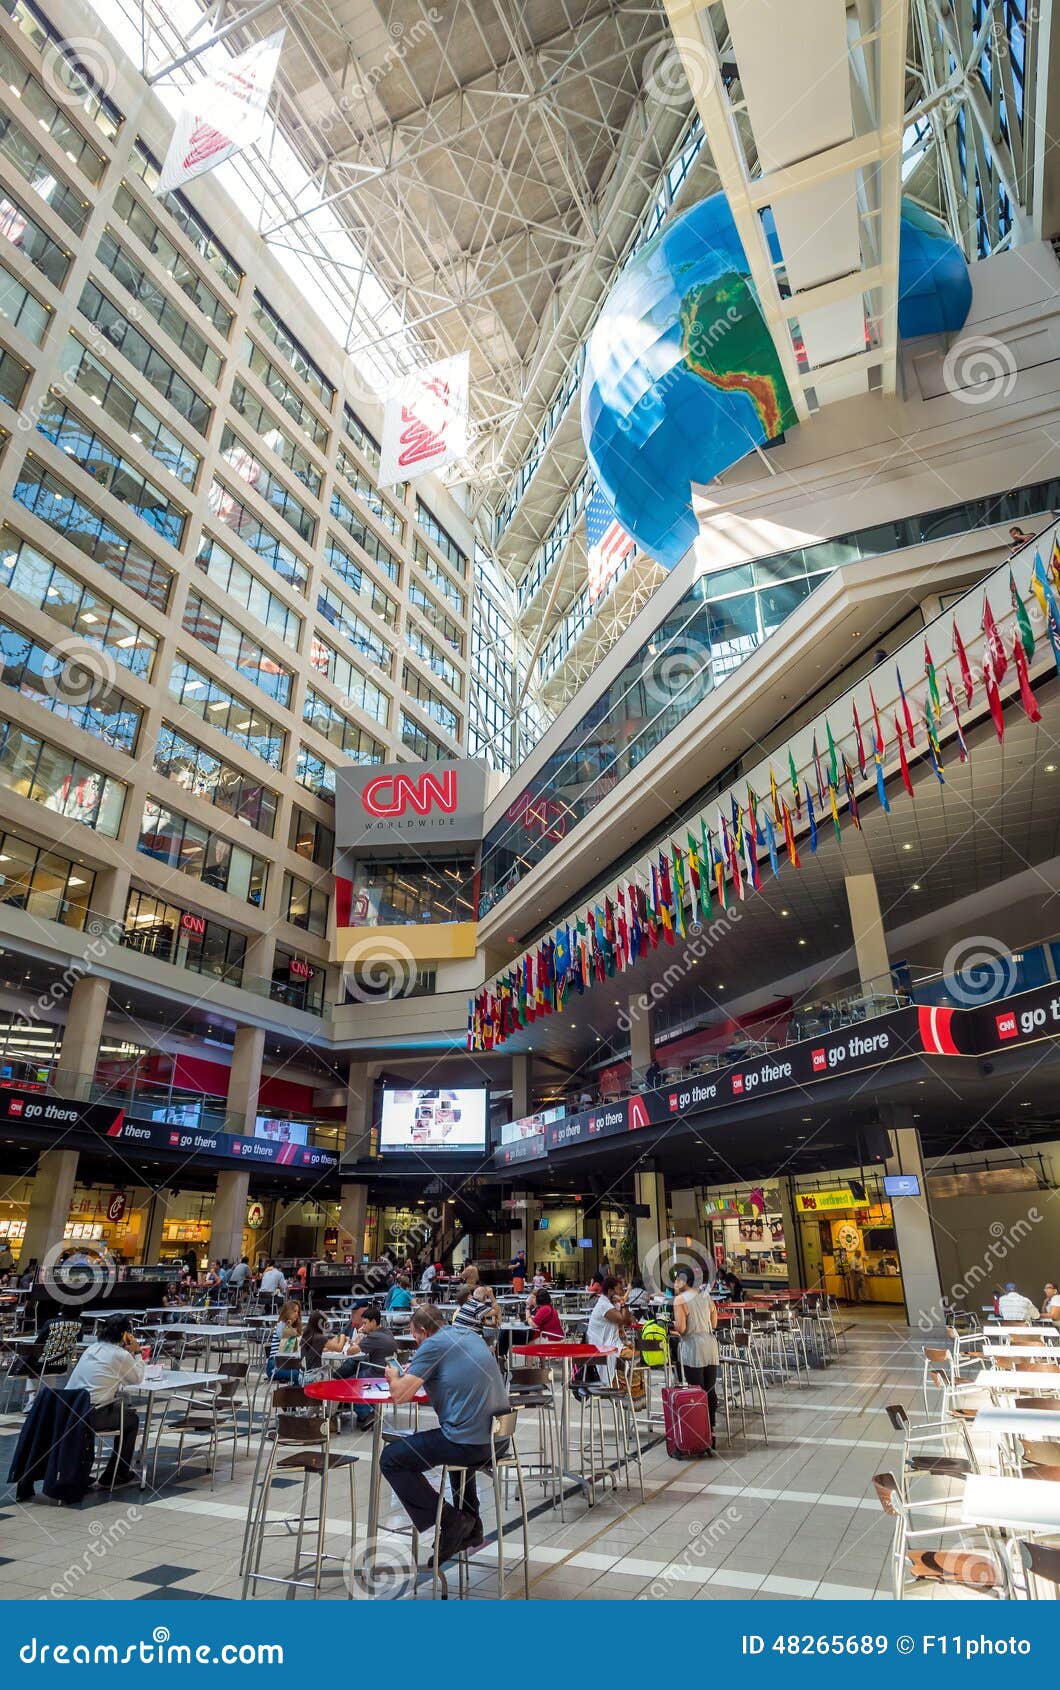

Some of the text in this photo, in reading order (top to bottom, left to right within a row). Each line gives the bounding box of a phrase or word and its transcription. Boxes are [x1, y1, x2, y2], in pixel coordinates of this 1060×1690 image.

[362, 769, 457, 818] CNN
[365, 818, 456, 830] WORLDWIDE
[181, 913, 205, 935] CNN
[1021, 1008, 1046, 1033] go
[828, 1046, 846, 1067] go
[848, 1032, 889, 1057] there
[745, 1072, 759, 1090] go
[761, 1062, 792, 1083] there
[679, 1092, 690, 1108] go
[692, 1084, 717, 1102] there
[24, 1104, 42, 1118] go
[45, 1106, 78, 1121] there
[596, 1118, 604, 1131] go
[605, 1112, 623, 1126] there
[125, 1125, 151, 1139] there
[180, 1135, 193, 1147] go
[194, 1135, 217, 1149] there
[241, 1144, 253, 1154] go
[253, 1144, 273, 1156] there
[311, 1154, 320, 1164] go
[320, 1154, 338, 1165] there
